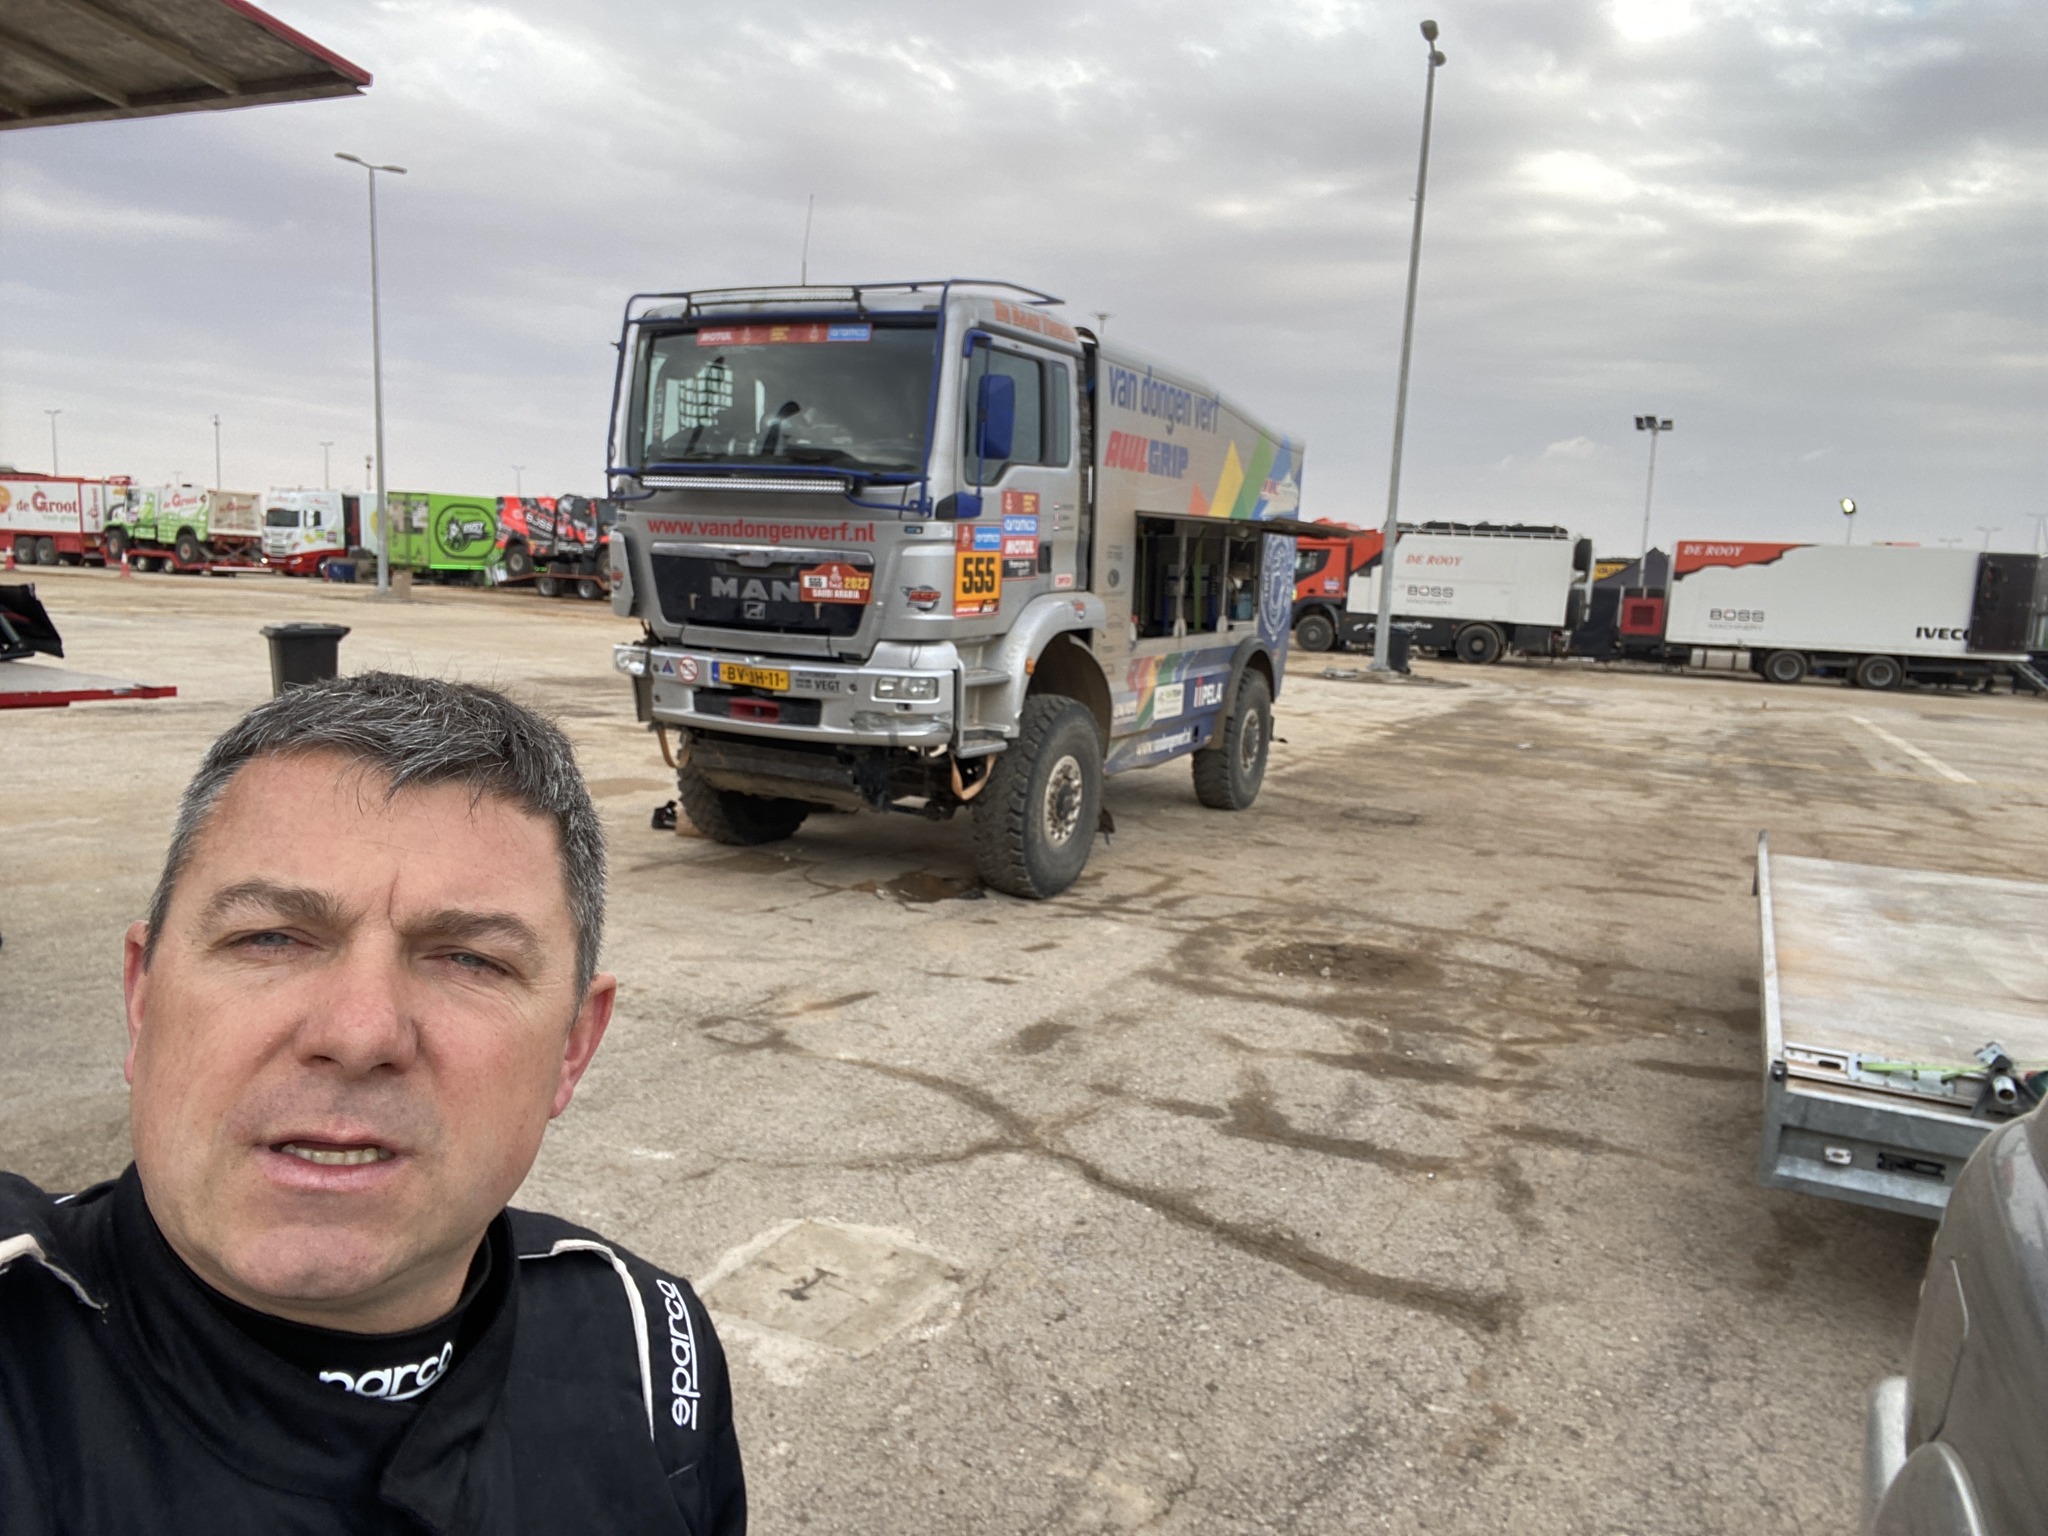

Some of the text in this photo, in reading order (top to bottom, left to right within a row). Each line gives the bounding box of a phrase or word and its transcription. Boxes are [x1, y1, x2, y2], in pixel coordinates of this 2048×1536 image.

[830, 327, 869, 337] aramco
[1108, 366, 1137, 412] van
[1141, 364, 1191, 436] dongen
[16, 490, 77, 513] de Groot
[647, 518, 876, 543] www.vandongenverf.nl
[1004, 518, 1037, 531] aramco
[1005, 540, 1034, 555] MOTUL
[1683, 544, 1744, 557] DE ROOY
[1406, 554, 1462, 567] DE ROOY
[962, 556, 995, 594] 555
[711, 576, 800, 602] MAN
[845, 577, 870, 590] 2023
[812, 589, 860, 599] SAUDI ARABIA
[1407, 585, 1454, 598] BOSS
[1710, 608, 1764, 622] BOSS
[814, 680, 840, 692] VEGT
